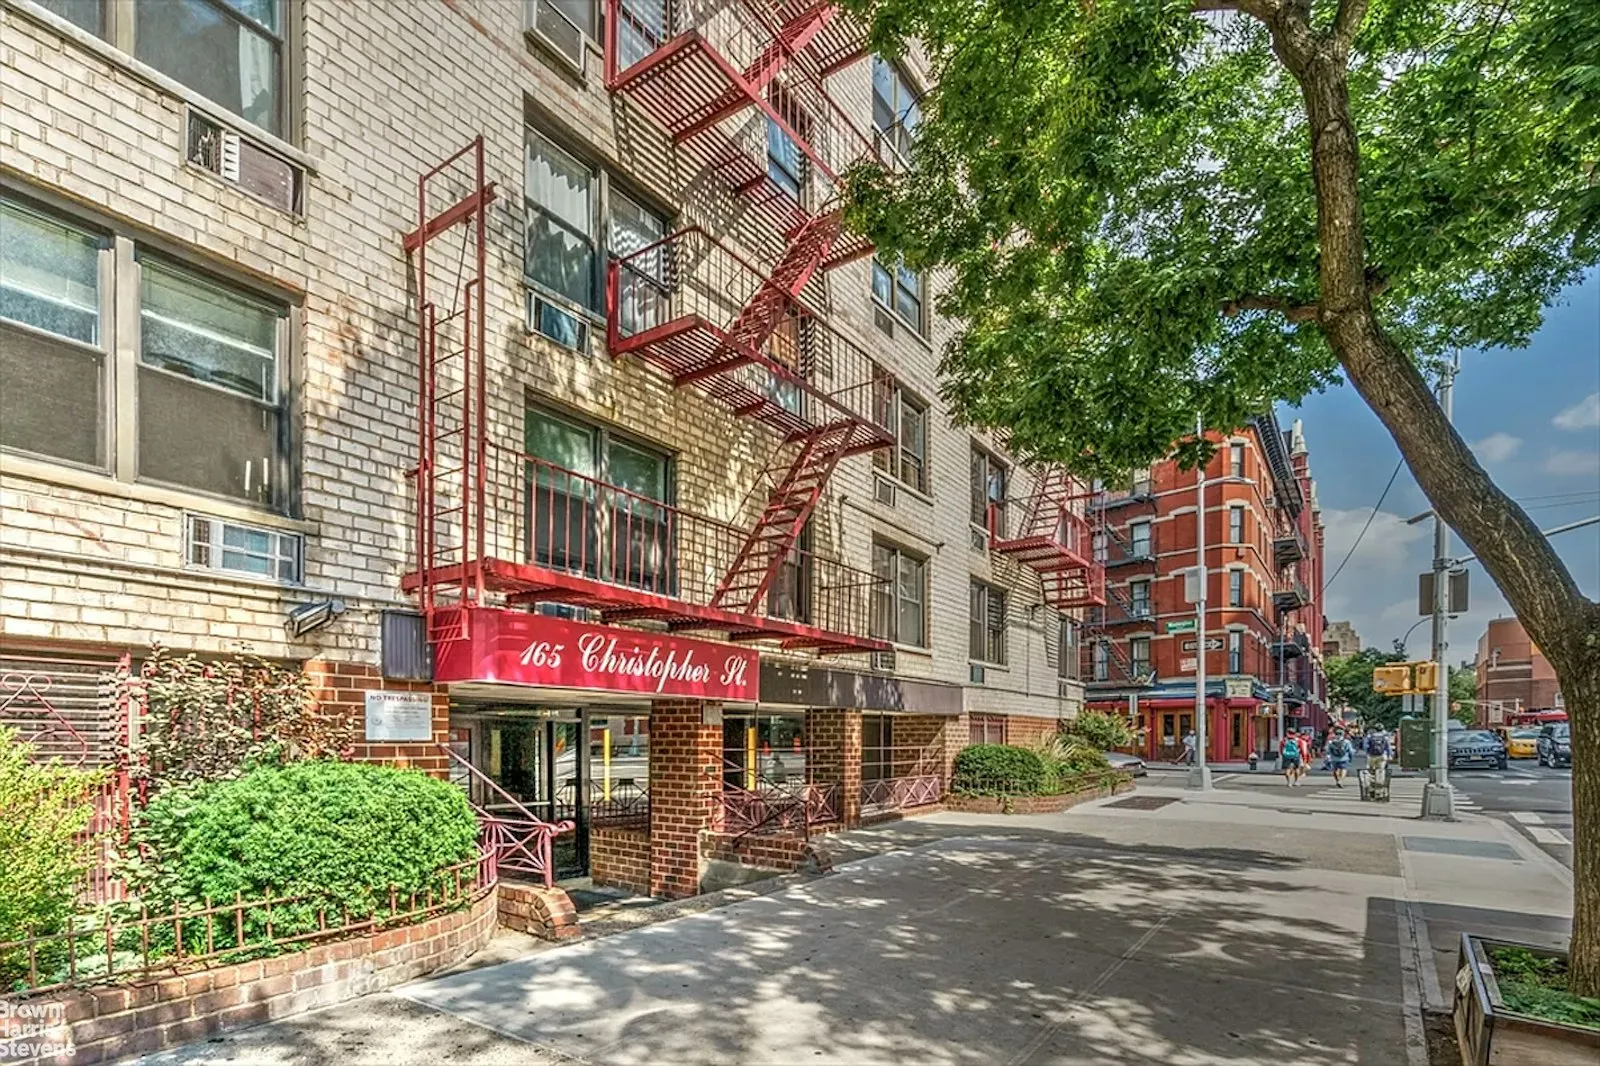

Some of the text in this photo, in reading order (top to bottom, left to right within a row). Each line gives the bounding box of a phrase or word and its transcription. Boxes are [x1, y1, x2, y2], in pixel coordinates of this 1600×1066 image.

[519, 632, 748, 693] 165 Christopher St.
